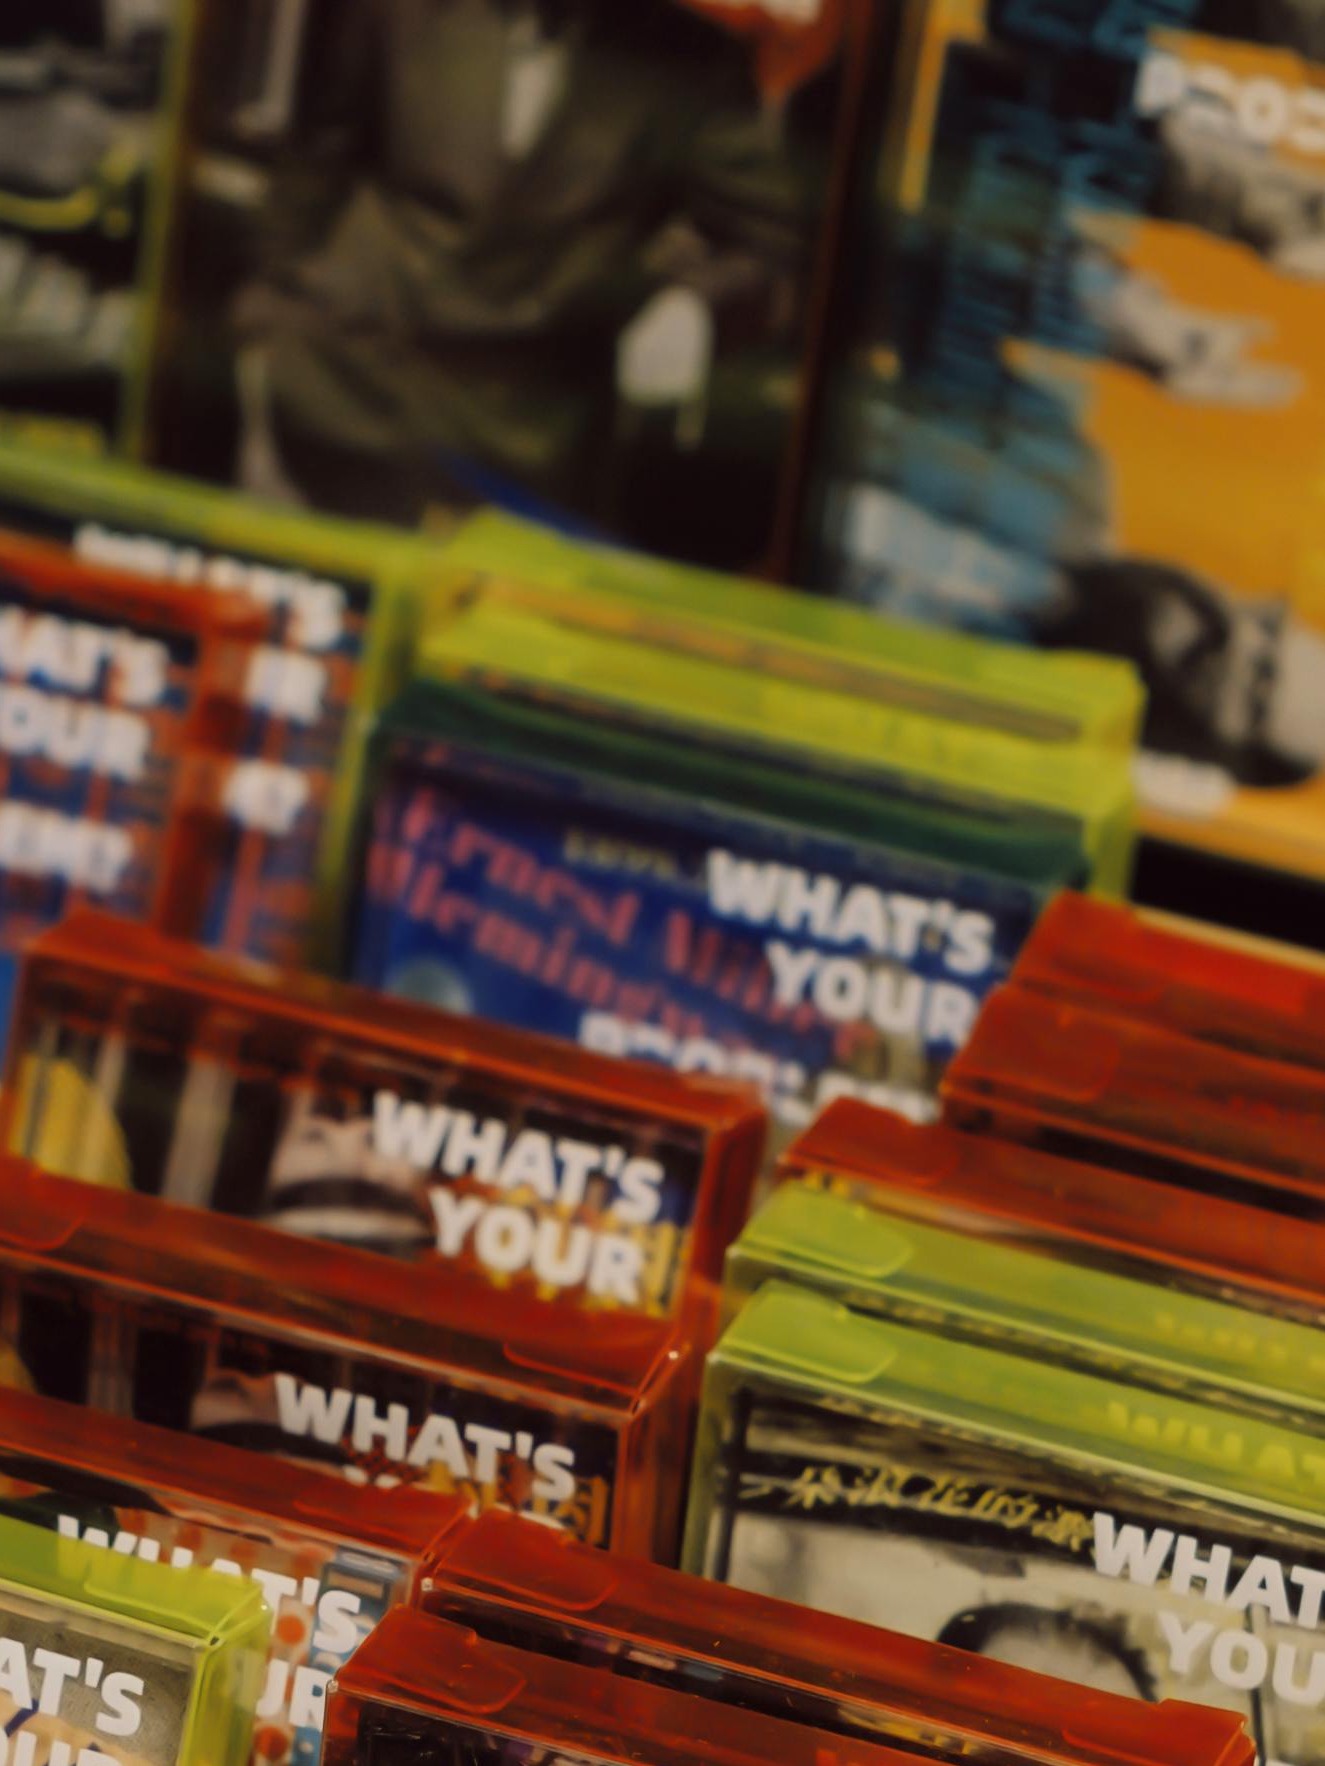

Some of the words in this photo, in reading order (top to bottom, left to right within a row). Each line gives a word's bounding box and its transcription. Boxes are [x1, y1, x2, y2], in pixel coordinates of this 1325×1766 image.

[707, 850, 995, 975] WHAT'S
[770, 940, 979, 1050] YOUR
[376, 1092, 665, 1225] WHAT'S
[431, 1190, 648, 1302] YOUR
[276, 1374, 574, 1501] WHAT'S
